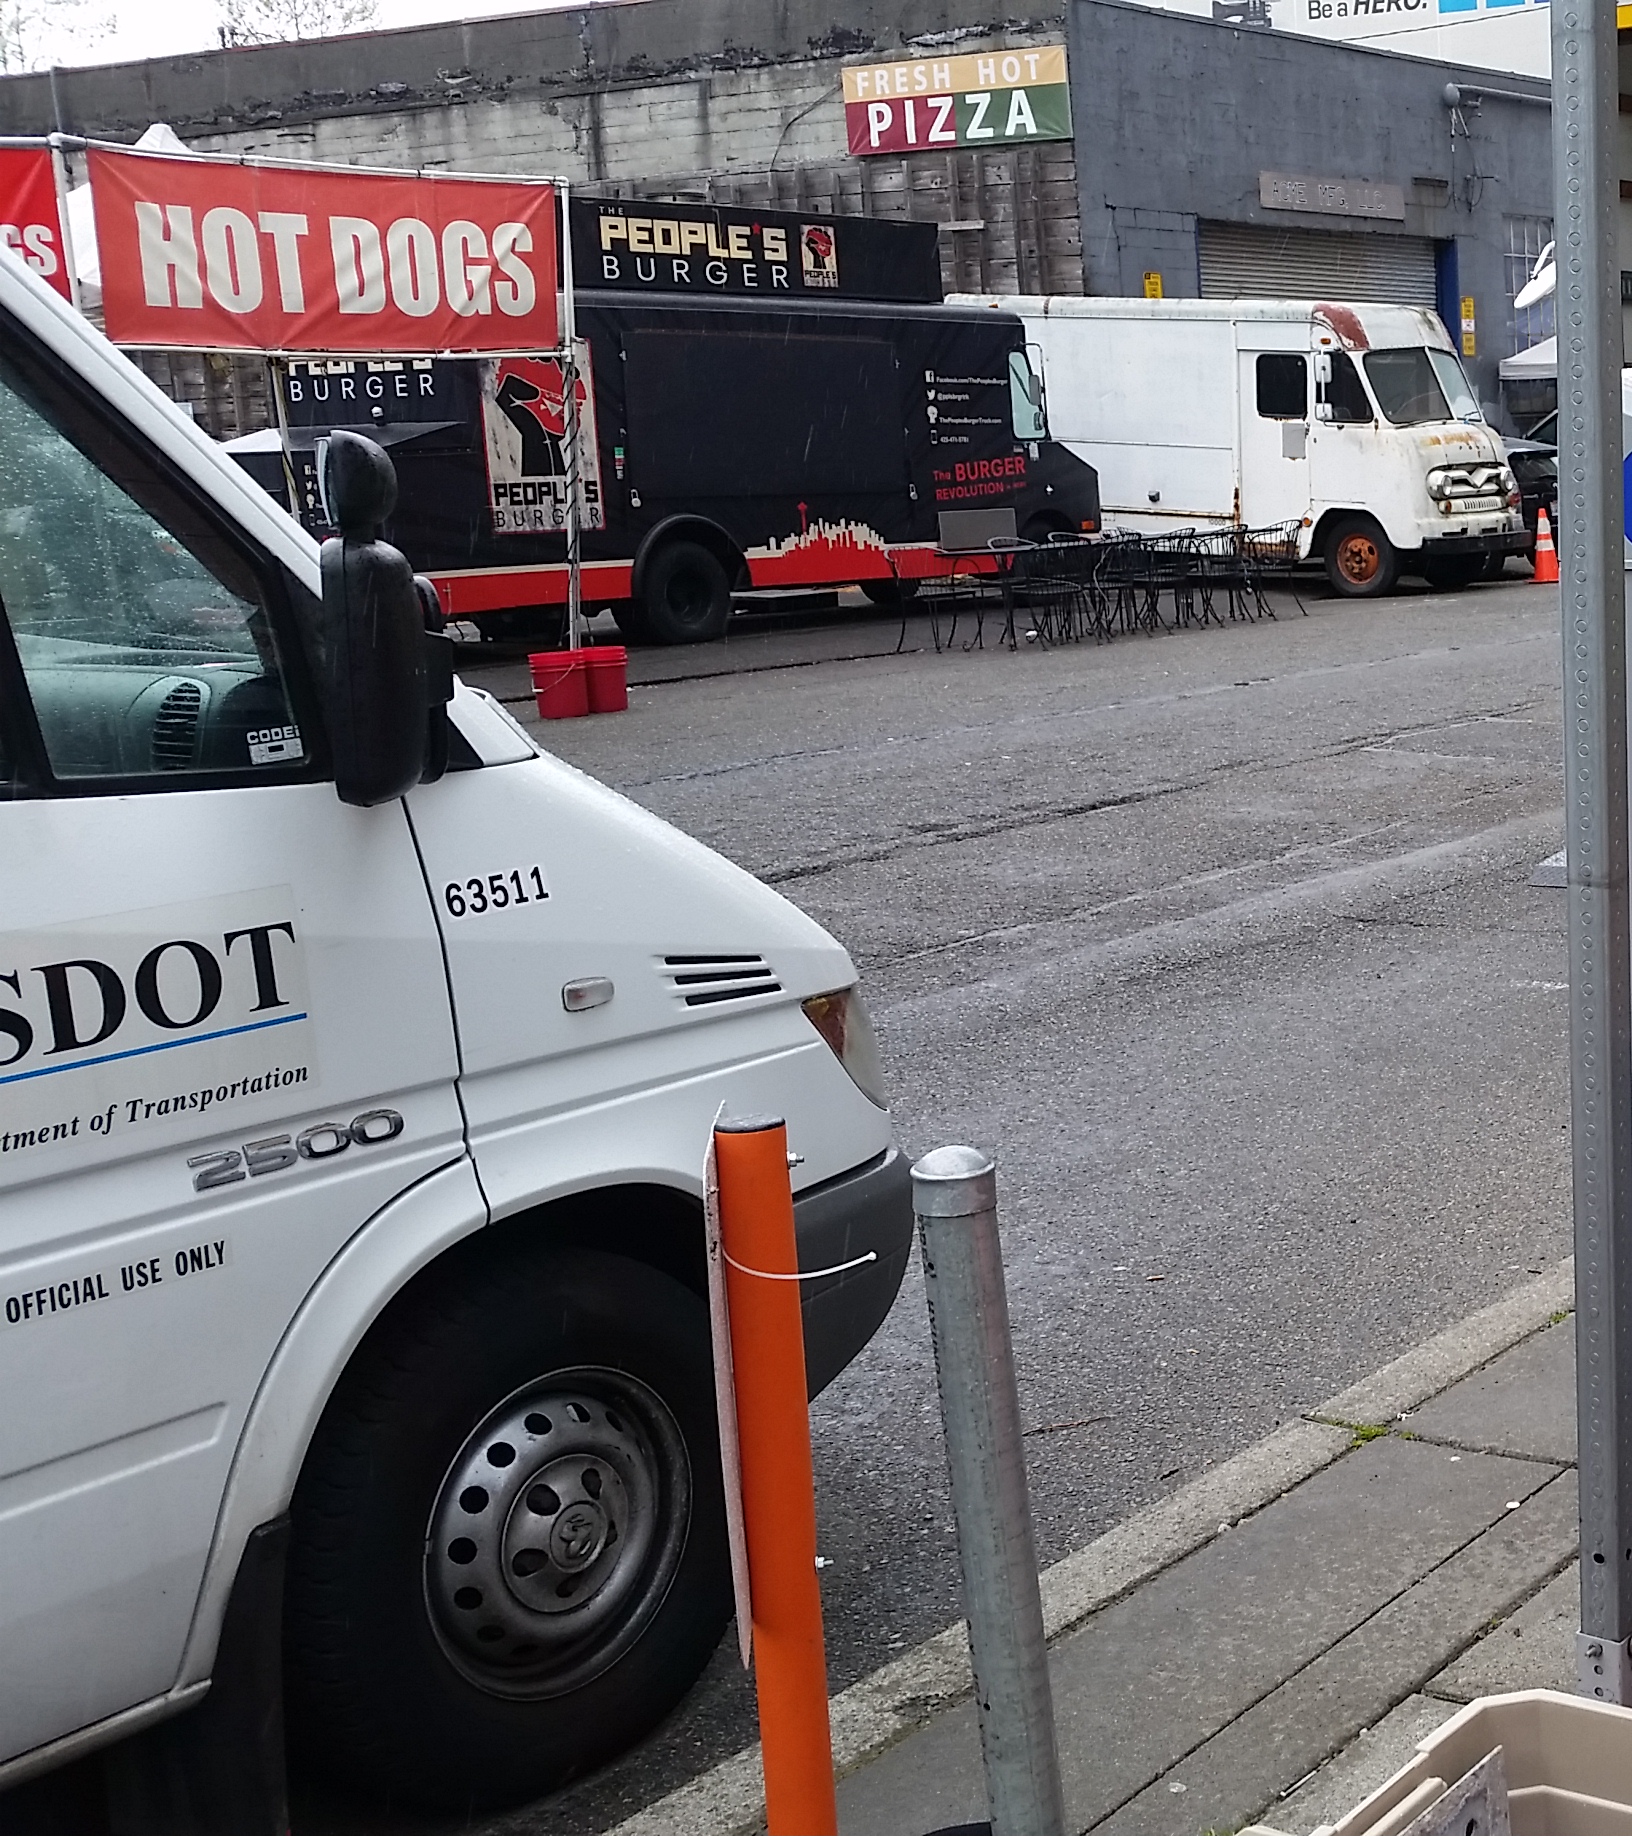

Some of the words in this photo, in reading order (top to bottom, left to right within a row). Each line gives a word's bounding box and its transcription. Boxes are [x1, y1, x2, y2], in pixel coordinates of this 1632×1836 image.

[1308, 0, 1333, 20] Be
[1337, 2, 1348, 17] a
[856, 63, 950, 97] FRESH
[978, 53, 1040, 84] HOT
[867, 90, 1038, 147] PIZZA
[600, 206, 625, 215] THE
[1272, 180, 1307, 204] ACME
[134, 201, 308, 314] HOT
[328, 217, 536, 318] DOGS
[602, 256, 790, 289] BURGER
[290, 374, 435, 402] BURGER
[933, 469, 951, 480] The
[955, 456, 1026, 481] BURGER
[936, 482, 1004, 501] REVOLUTION
[495, 507, 600, 527] BURGR
[445, 866, 550, 918] 63511
[0, 921, 296, 1066] SDOT
[90, 1105, 117, 1135] of
[125, 1066, 309, 1124] Transportation
[187, 1108, 404, 1193] 2500
[5, 1273, 109, 1324] OFFICIAL
[121, 1257, 162, 1291] USE
[174, 1240, 226, 1276] ONLY
